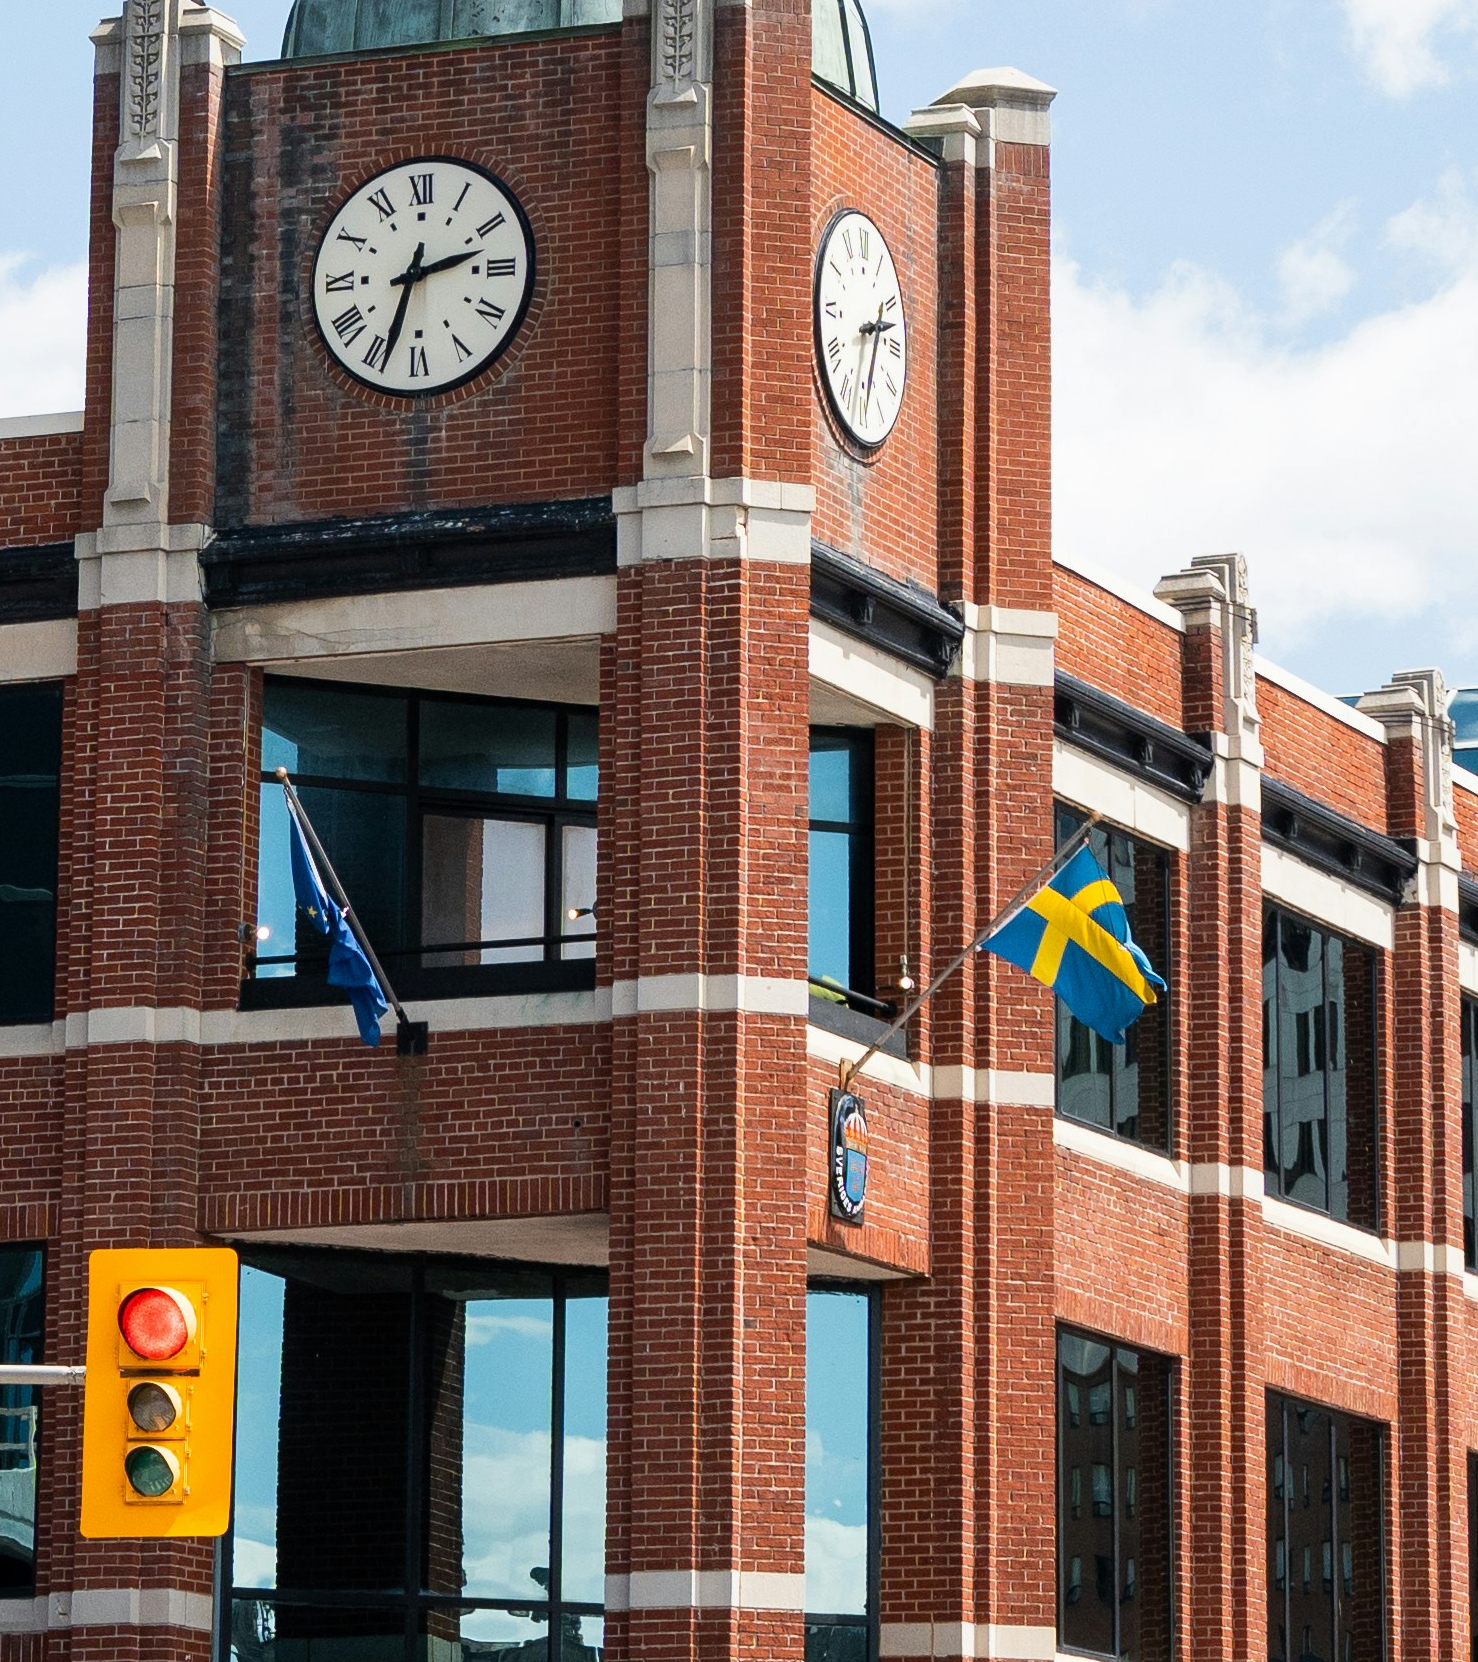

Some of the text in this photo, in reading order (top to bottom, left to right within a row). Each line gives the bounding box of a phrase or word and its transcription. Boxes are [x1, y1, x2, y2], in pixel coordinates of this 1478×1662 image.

[408, 173, 434, 206] XII
[367, 187, 397, 223] XI
[336, 227, 368, 252] X
[325, 270, 354, 294] IX
